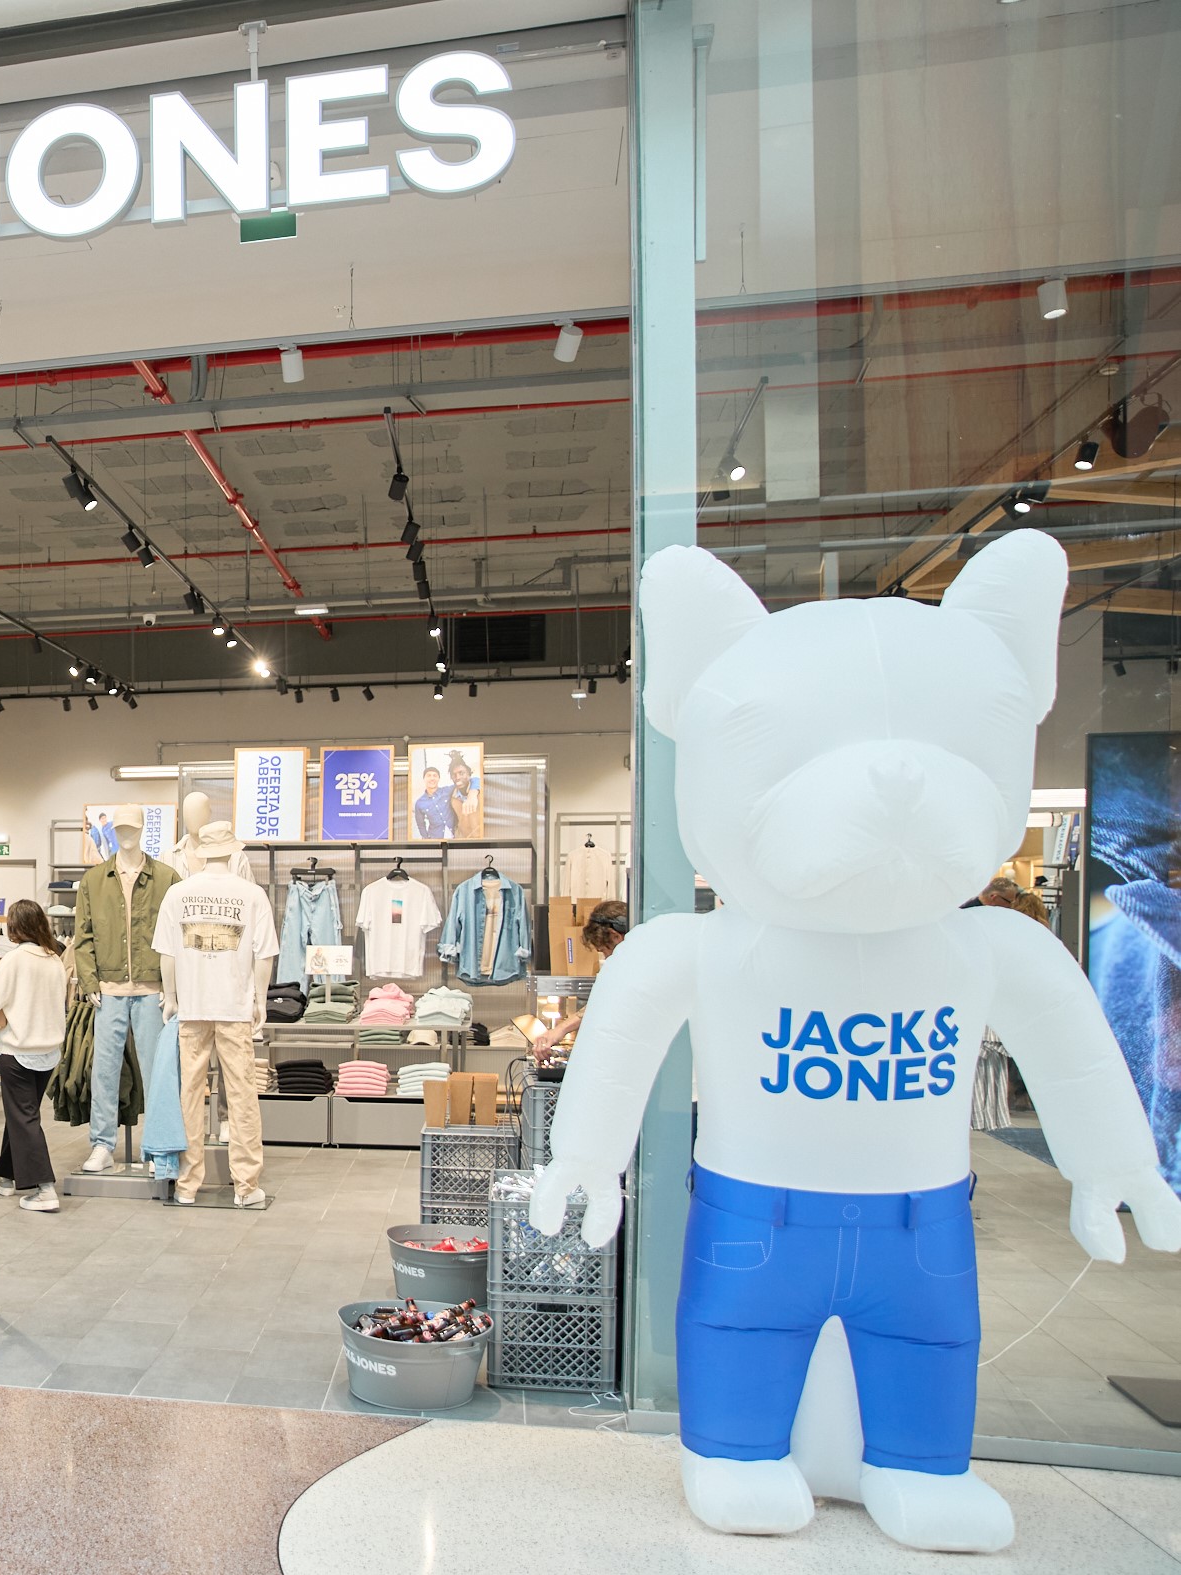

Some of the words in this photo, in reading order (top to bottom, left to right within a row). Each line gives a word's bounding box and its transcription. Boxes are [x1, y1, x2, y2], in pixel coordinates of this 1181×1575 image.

[255, 755, 269, 837] ABERTURA
[268, 755, 281, 814] OFERTA
[335, 772, 378, 790] 25%
[341, 789, 371, 806] EM
[146, 808, 154, 853] ABERTUR
[153, 808, 162, 845] OFERTA
[267, 817, 279, 837] DE
[181, 896, 230, 905] ORIGINALS
[231, 898, 245, 907] CO.
[182, 904, 242, 921] ATELIER
[761, 1005, 959, 1056] JACK&
[760, 1052, 956, 1102] JONES
